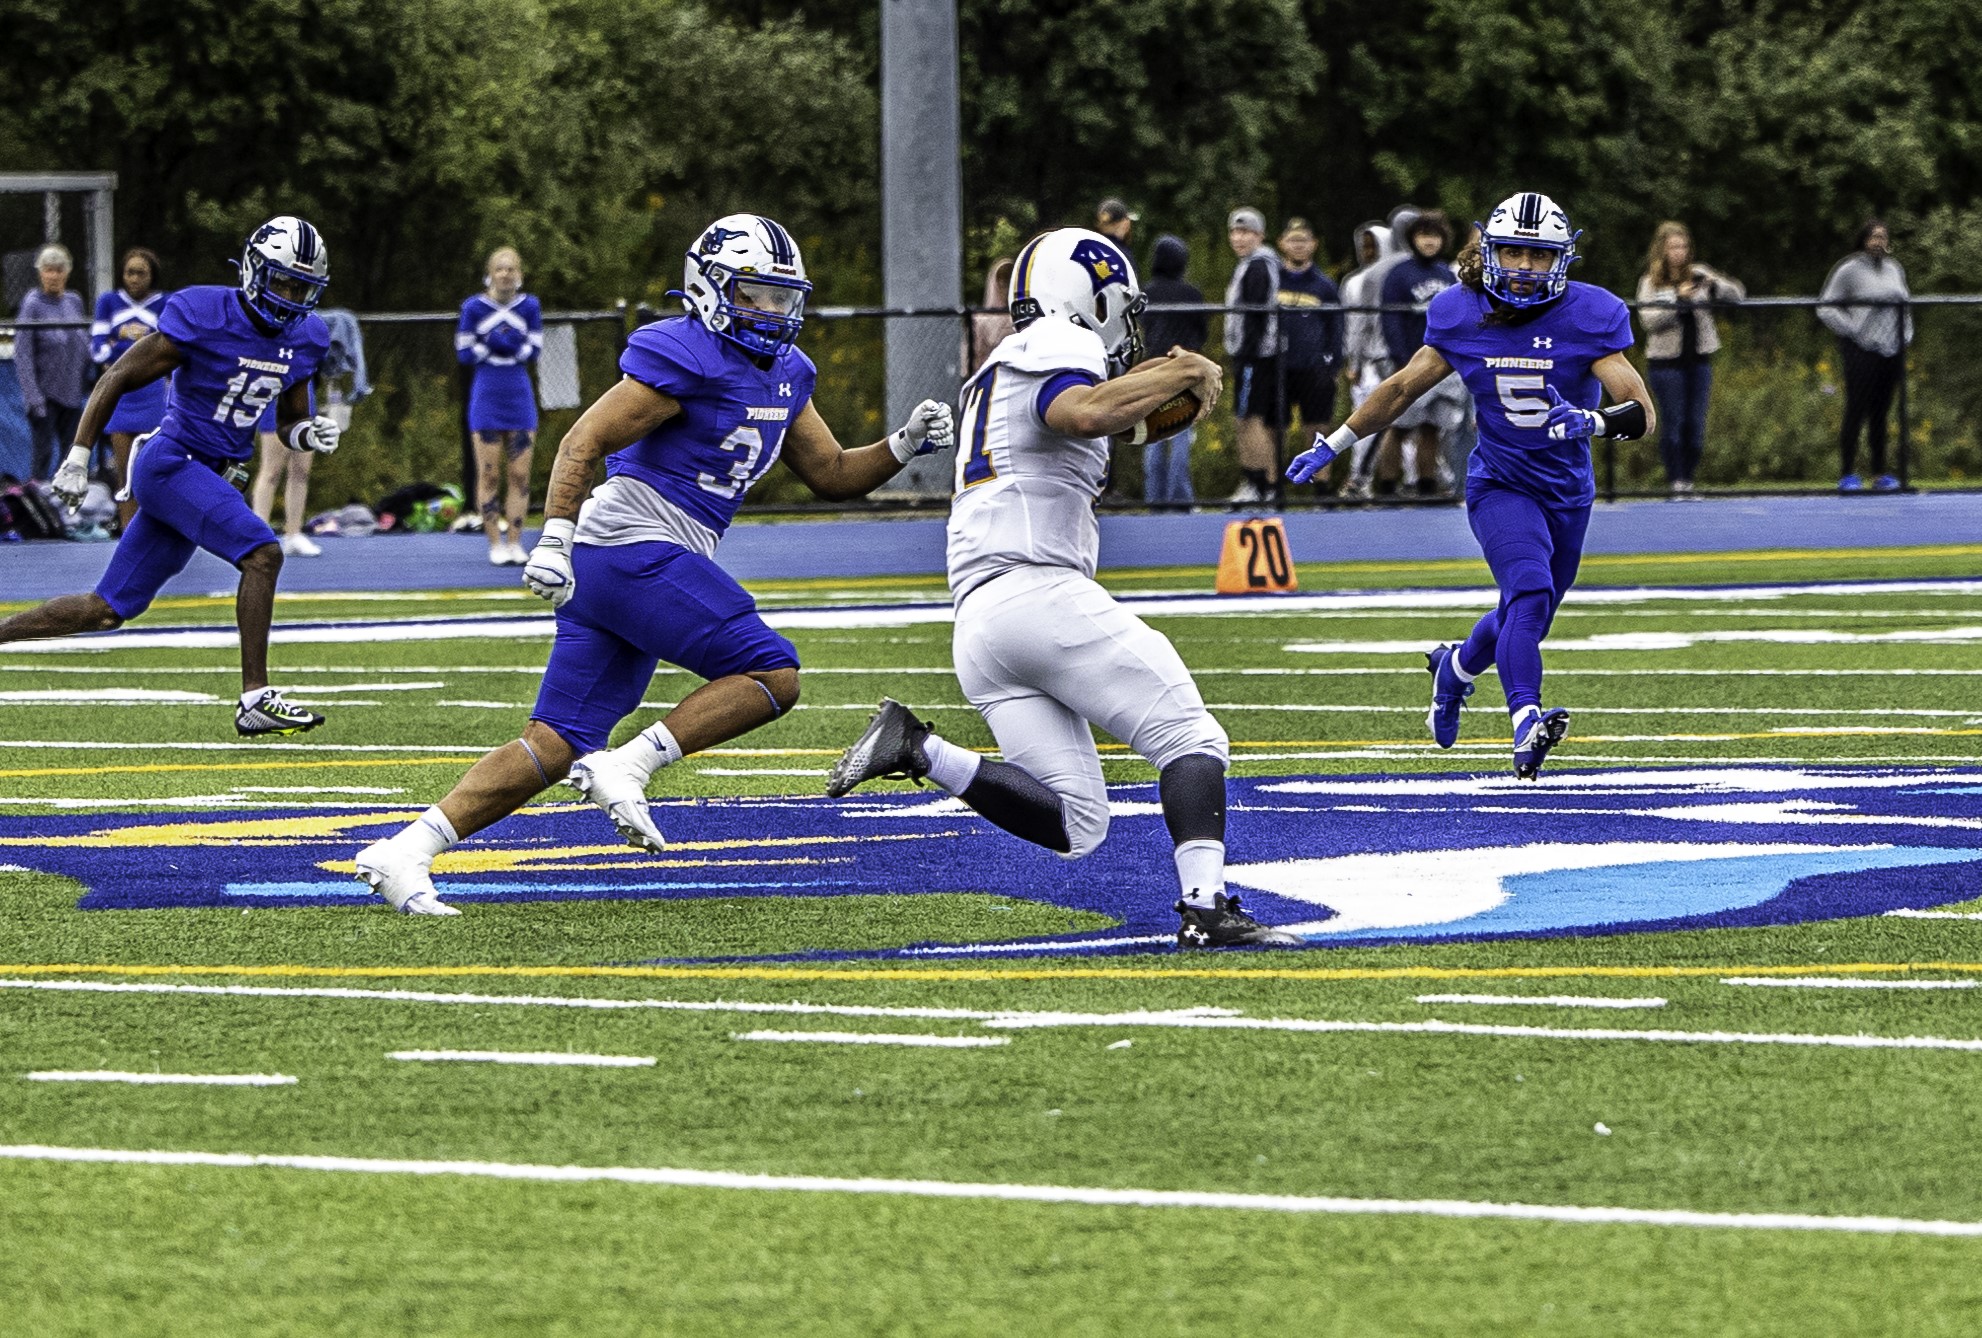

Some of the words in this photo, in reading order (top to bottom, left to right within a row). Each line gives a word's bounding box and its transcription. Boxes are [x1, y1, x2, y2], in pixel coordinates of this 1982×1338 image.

[1012, 303, 1037, 316] ICIS
[237, 356, 290, 375] PIONEERS
[1483, 356, 1554, 370] PIONEERS
[212, 371, 283, 428] 19
[1495, 374, 1550, 428] 5
[745, 406, 789, 421] PIONEERS
[1240, 525, 1290, 588] 20
